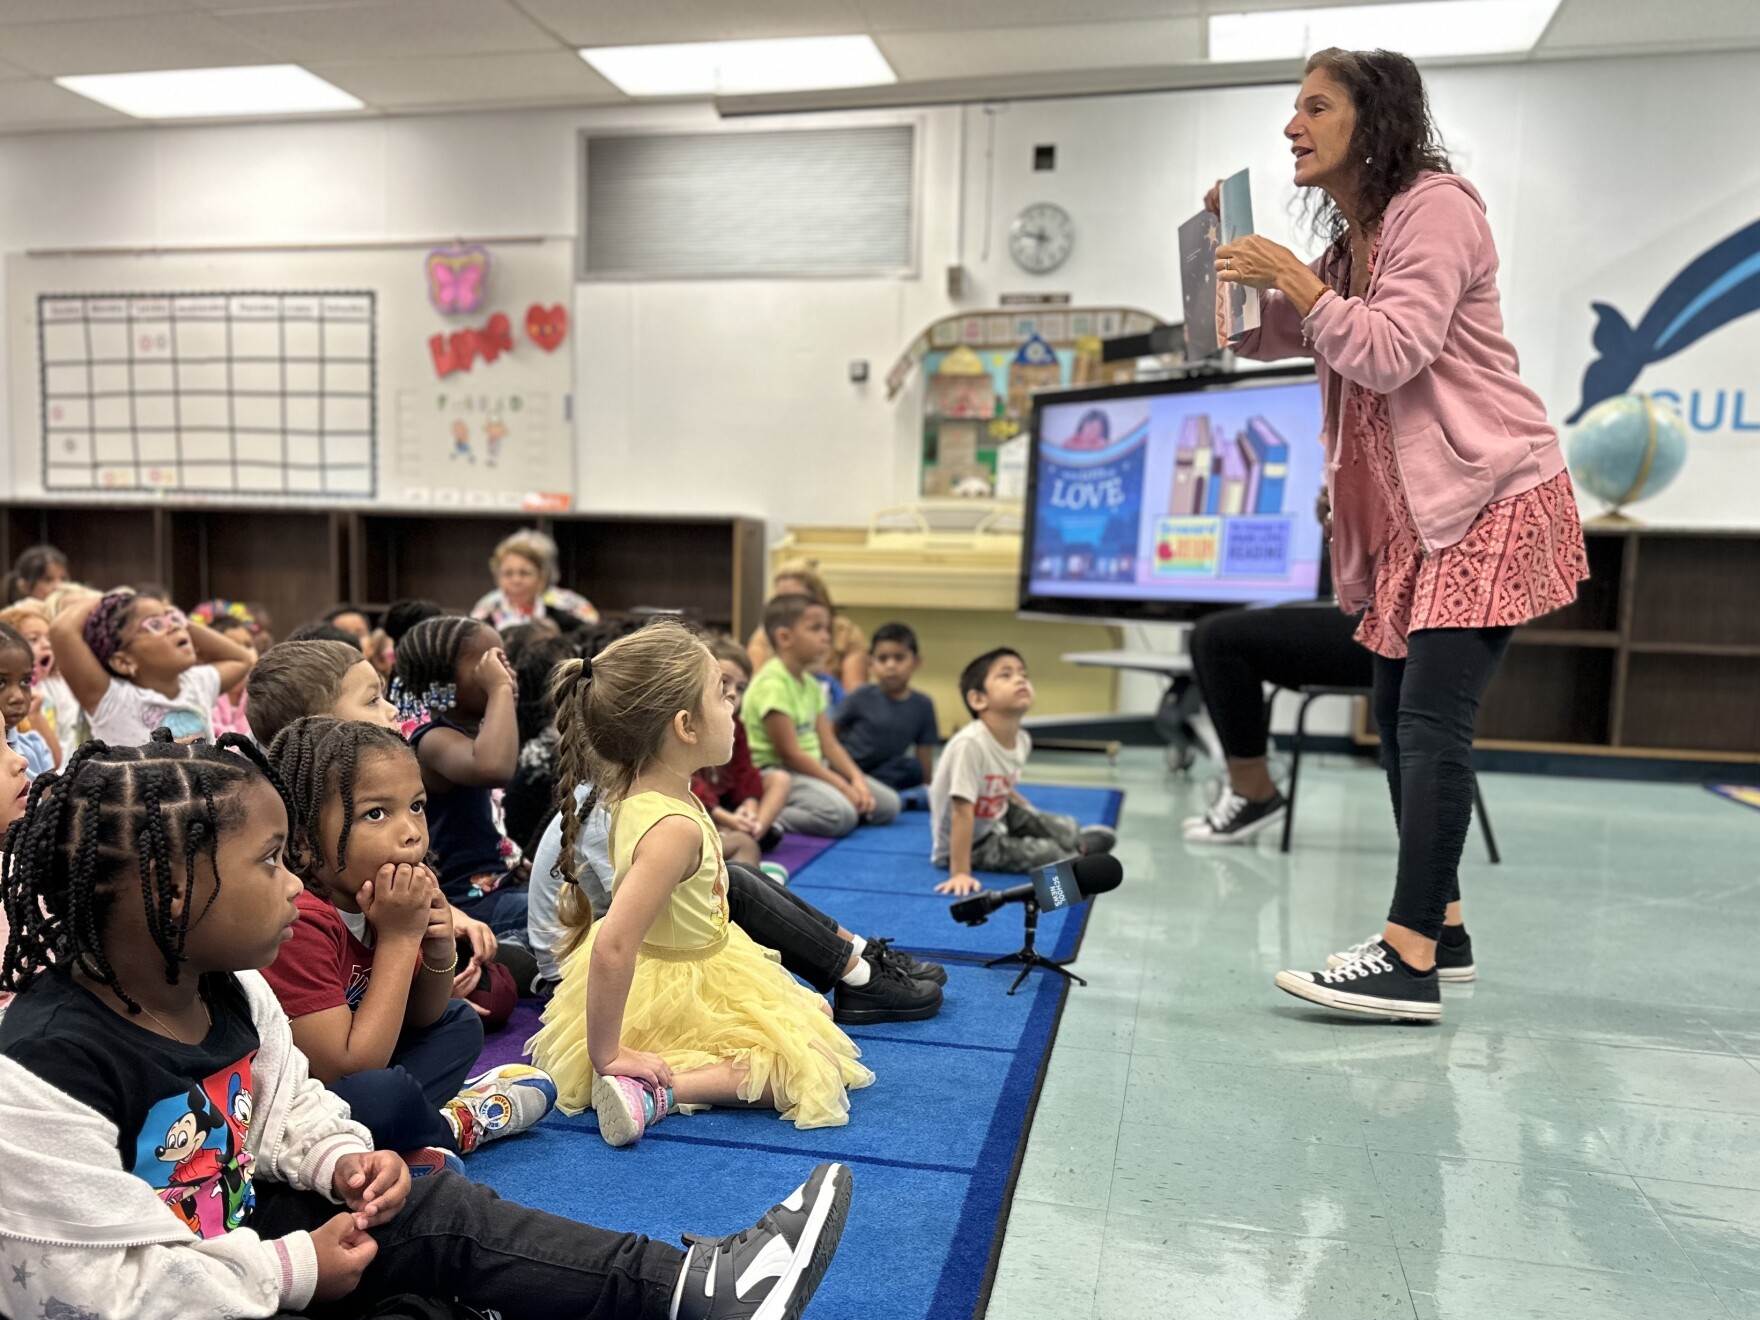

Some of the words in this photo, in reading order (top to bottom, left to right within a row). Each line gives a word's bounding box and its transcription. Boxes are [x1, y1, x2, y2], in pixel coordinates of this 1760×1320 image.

[1051, 477, 1125, 510] LOVE
[1049, 885, 1061, 906] NEWS
[1052, 876, 1066, 905] SCHOOL
